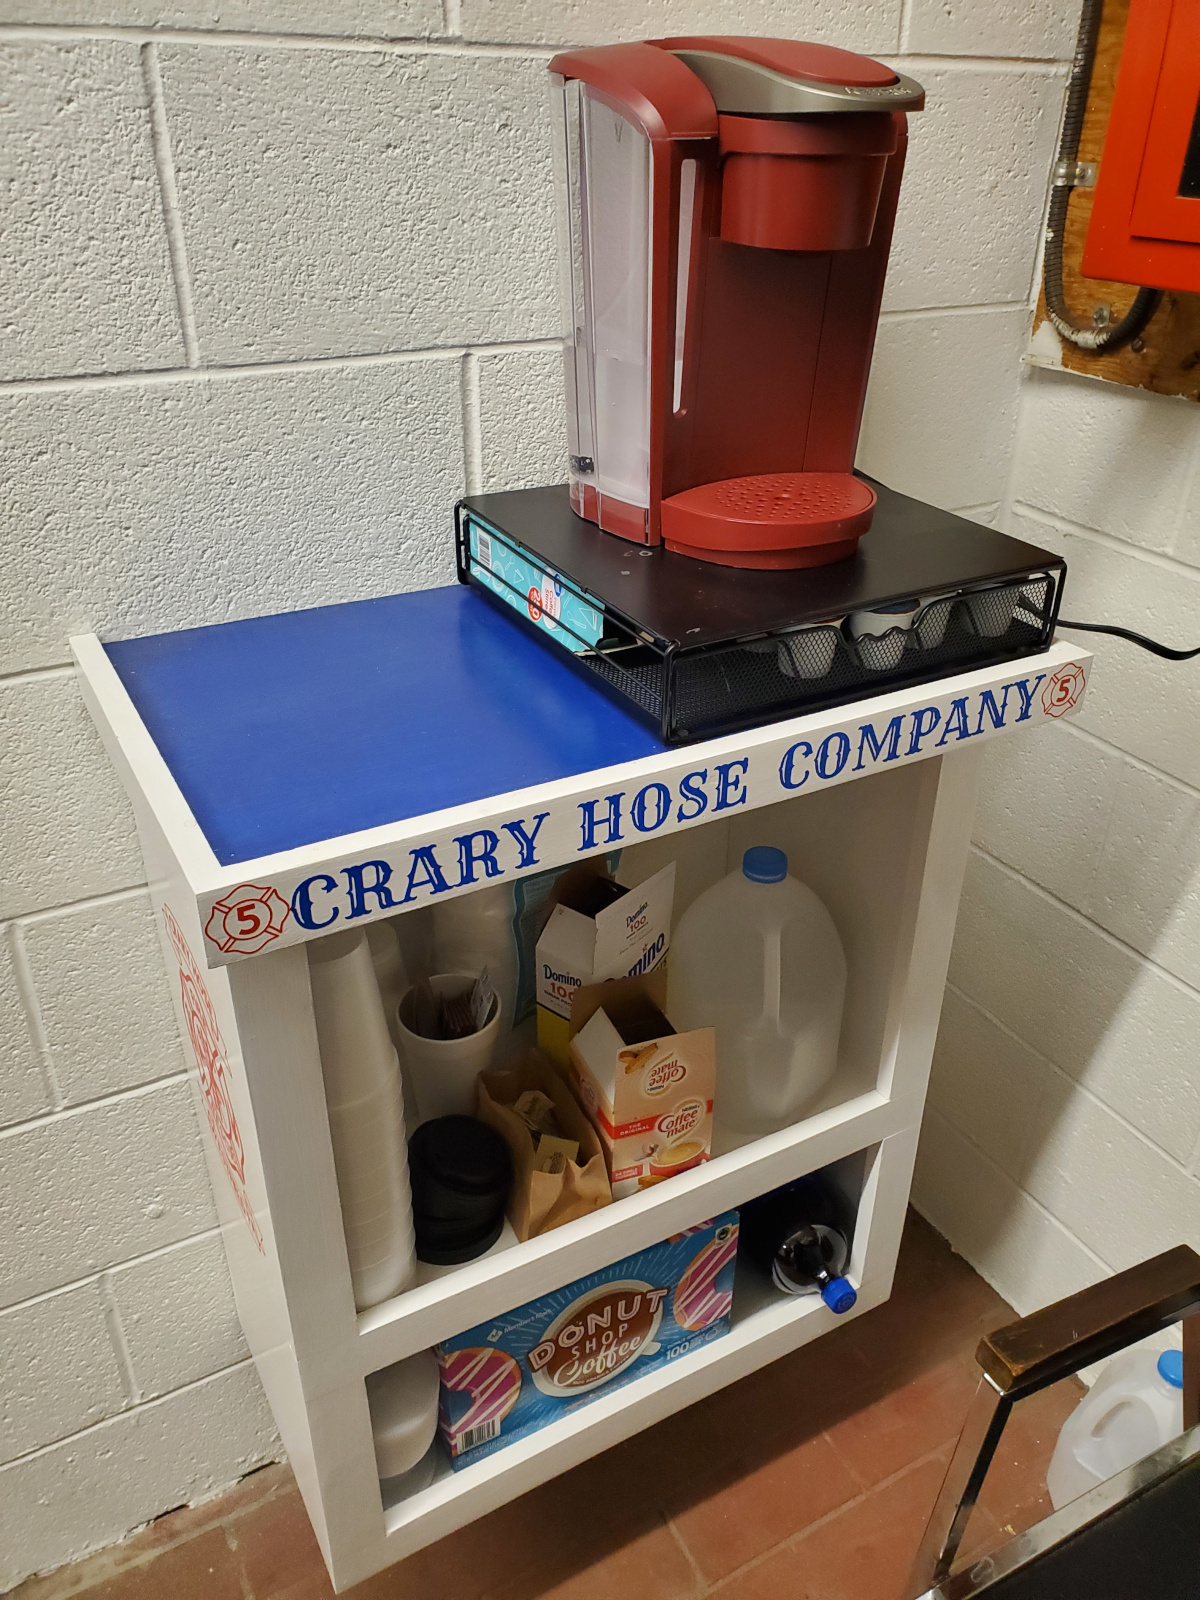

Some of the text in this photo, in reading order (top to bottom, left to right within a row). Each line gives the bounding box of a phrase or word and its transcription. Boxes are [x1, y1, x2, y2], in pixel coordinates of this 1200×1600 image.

[1056, 678, 1071, 702] 5
[291, 675, 1045, 929] CRARY HOSE COMPANY
[237, 903, 261, 935] 5
[626, 902, 649, 928] Domino
[630, 915, 647, 932] 100
[543, 964, 582, 988] Domino
[649, 1065, 687, 1086] Coffee
[651, 1060, 678, 1077] mate
[620, 1125, 649, 1136] ORIGINAL
[658, 1109, 698, 1132] Coffee
[666, 1119, 696, 1138] mate
[528, 1289, 668, 1371] DONUT
[571, 1323, 628, 1360] SHOP
[554, 1337, 641, 1387] Coffee
[666, 1341, 690, 1361] 100
